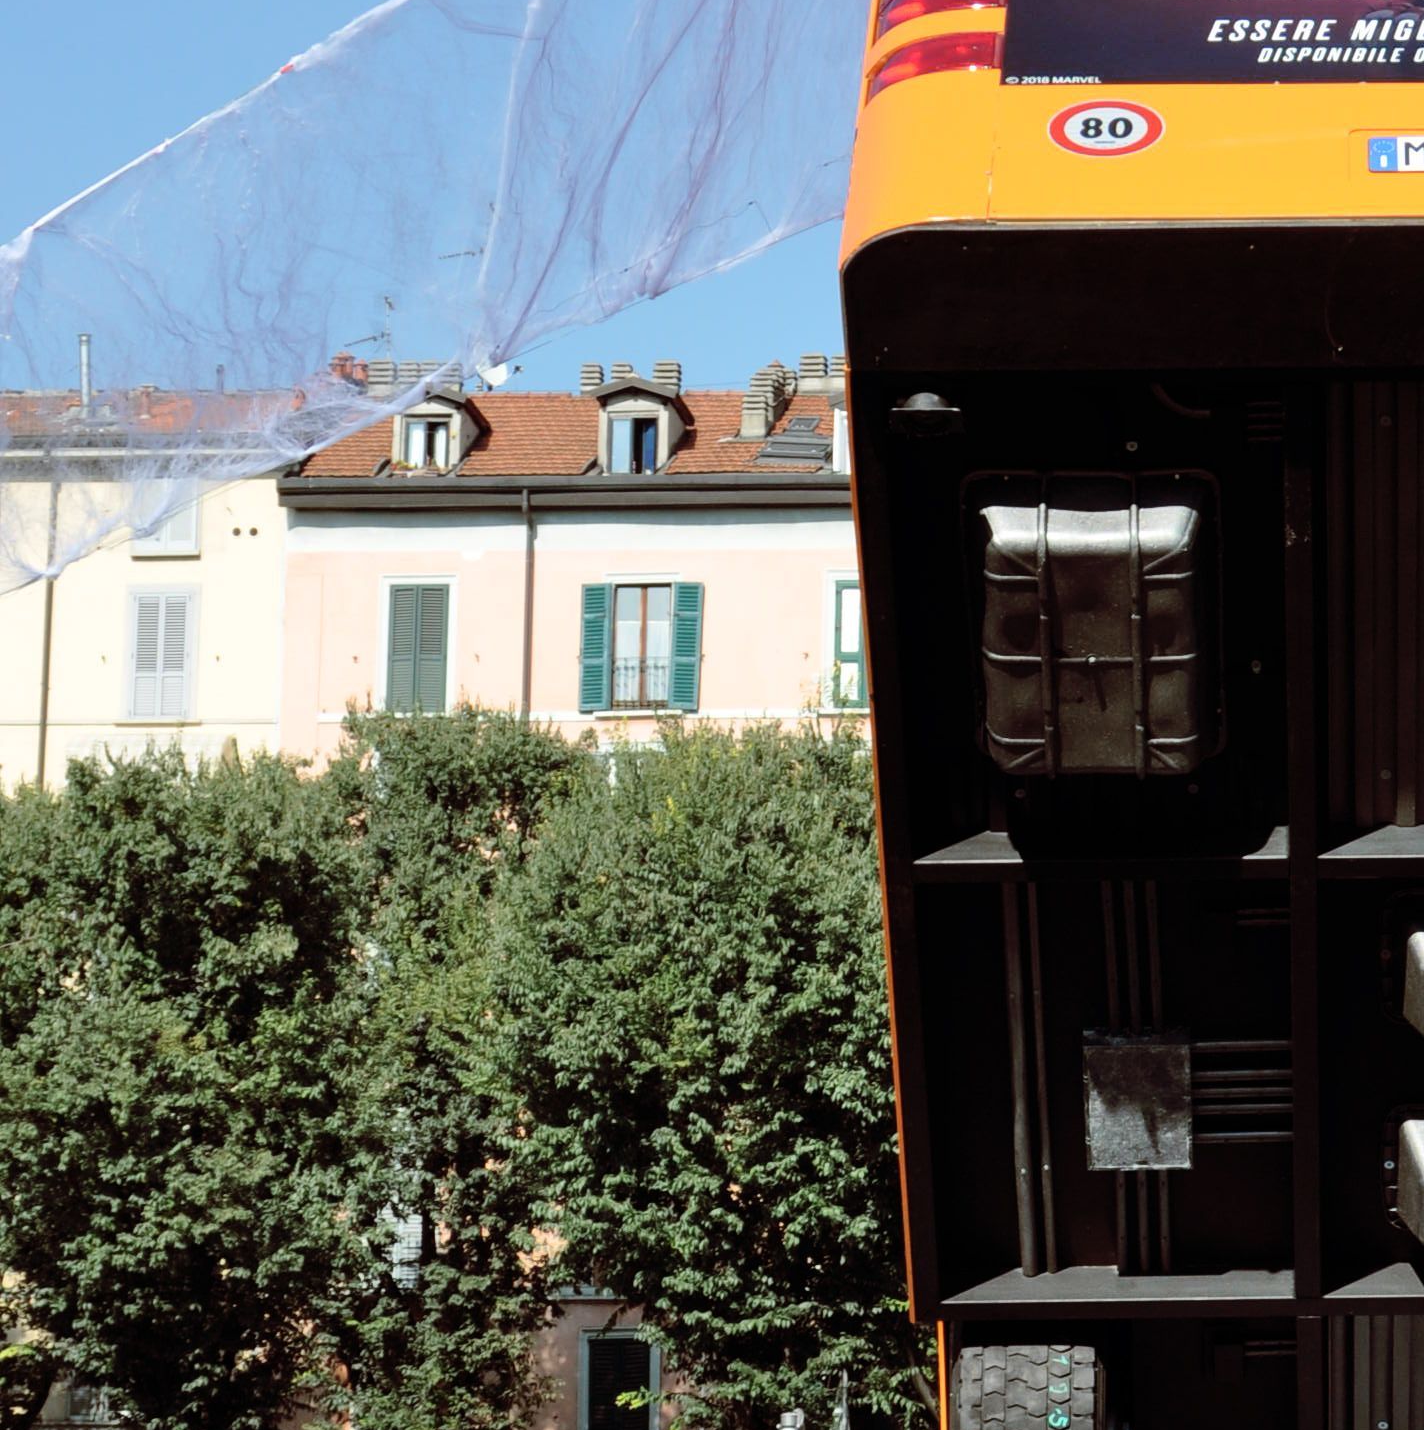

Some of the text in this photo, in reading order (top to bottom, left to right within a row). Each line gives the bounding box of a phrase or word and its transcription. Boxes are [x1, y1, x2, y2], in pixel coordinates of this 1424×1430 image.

[1207, 19, 1338, 43] ESSERE
[1257, 46, 1405, 64] DISPONIBILE
[1021, 76, 1049, 84] 2018
[1052, 76, 1102, 84] MARVEL
[1080, 117, 1133, 139] 80
